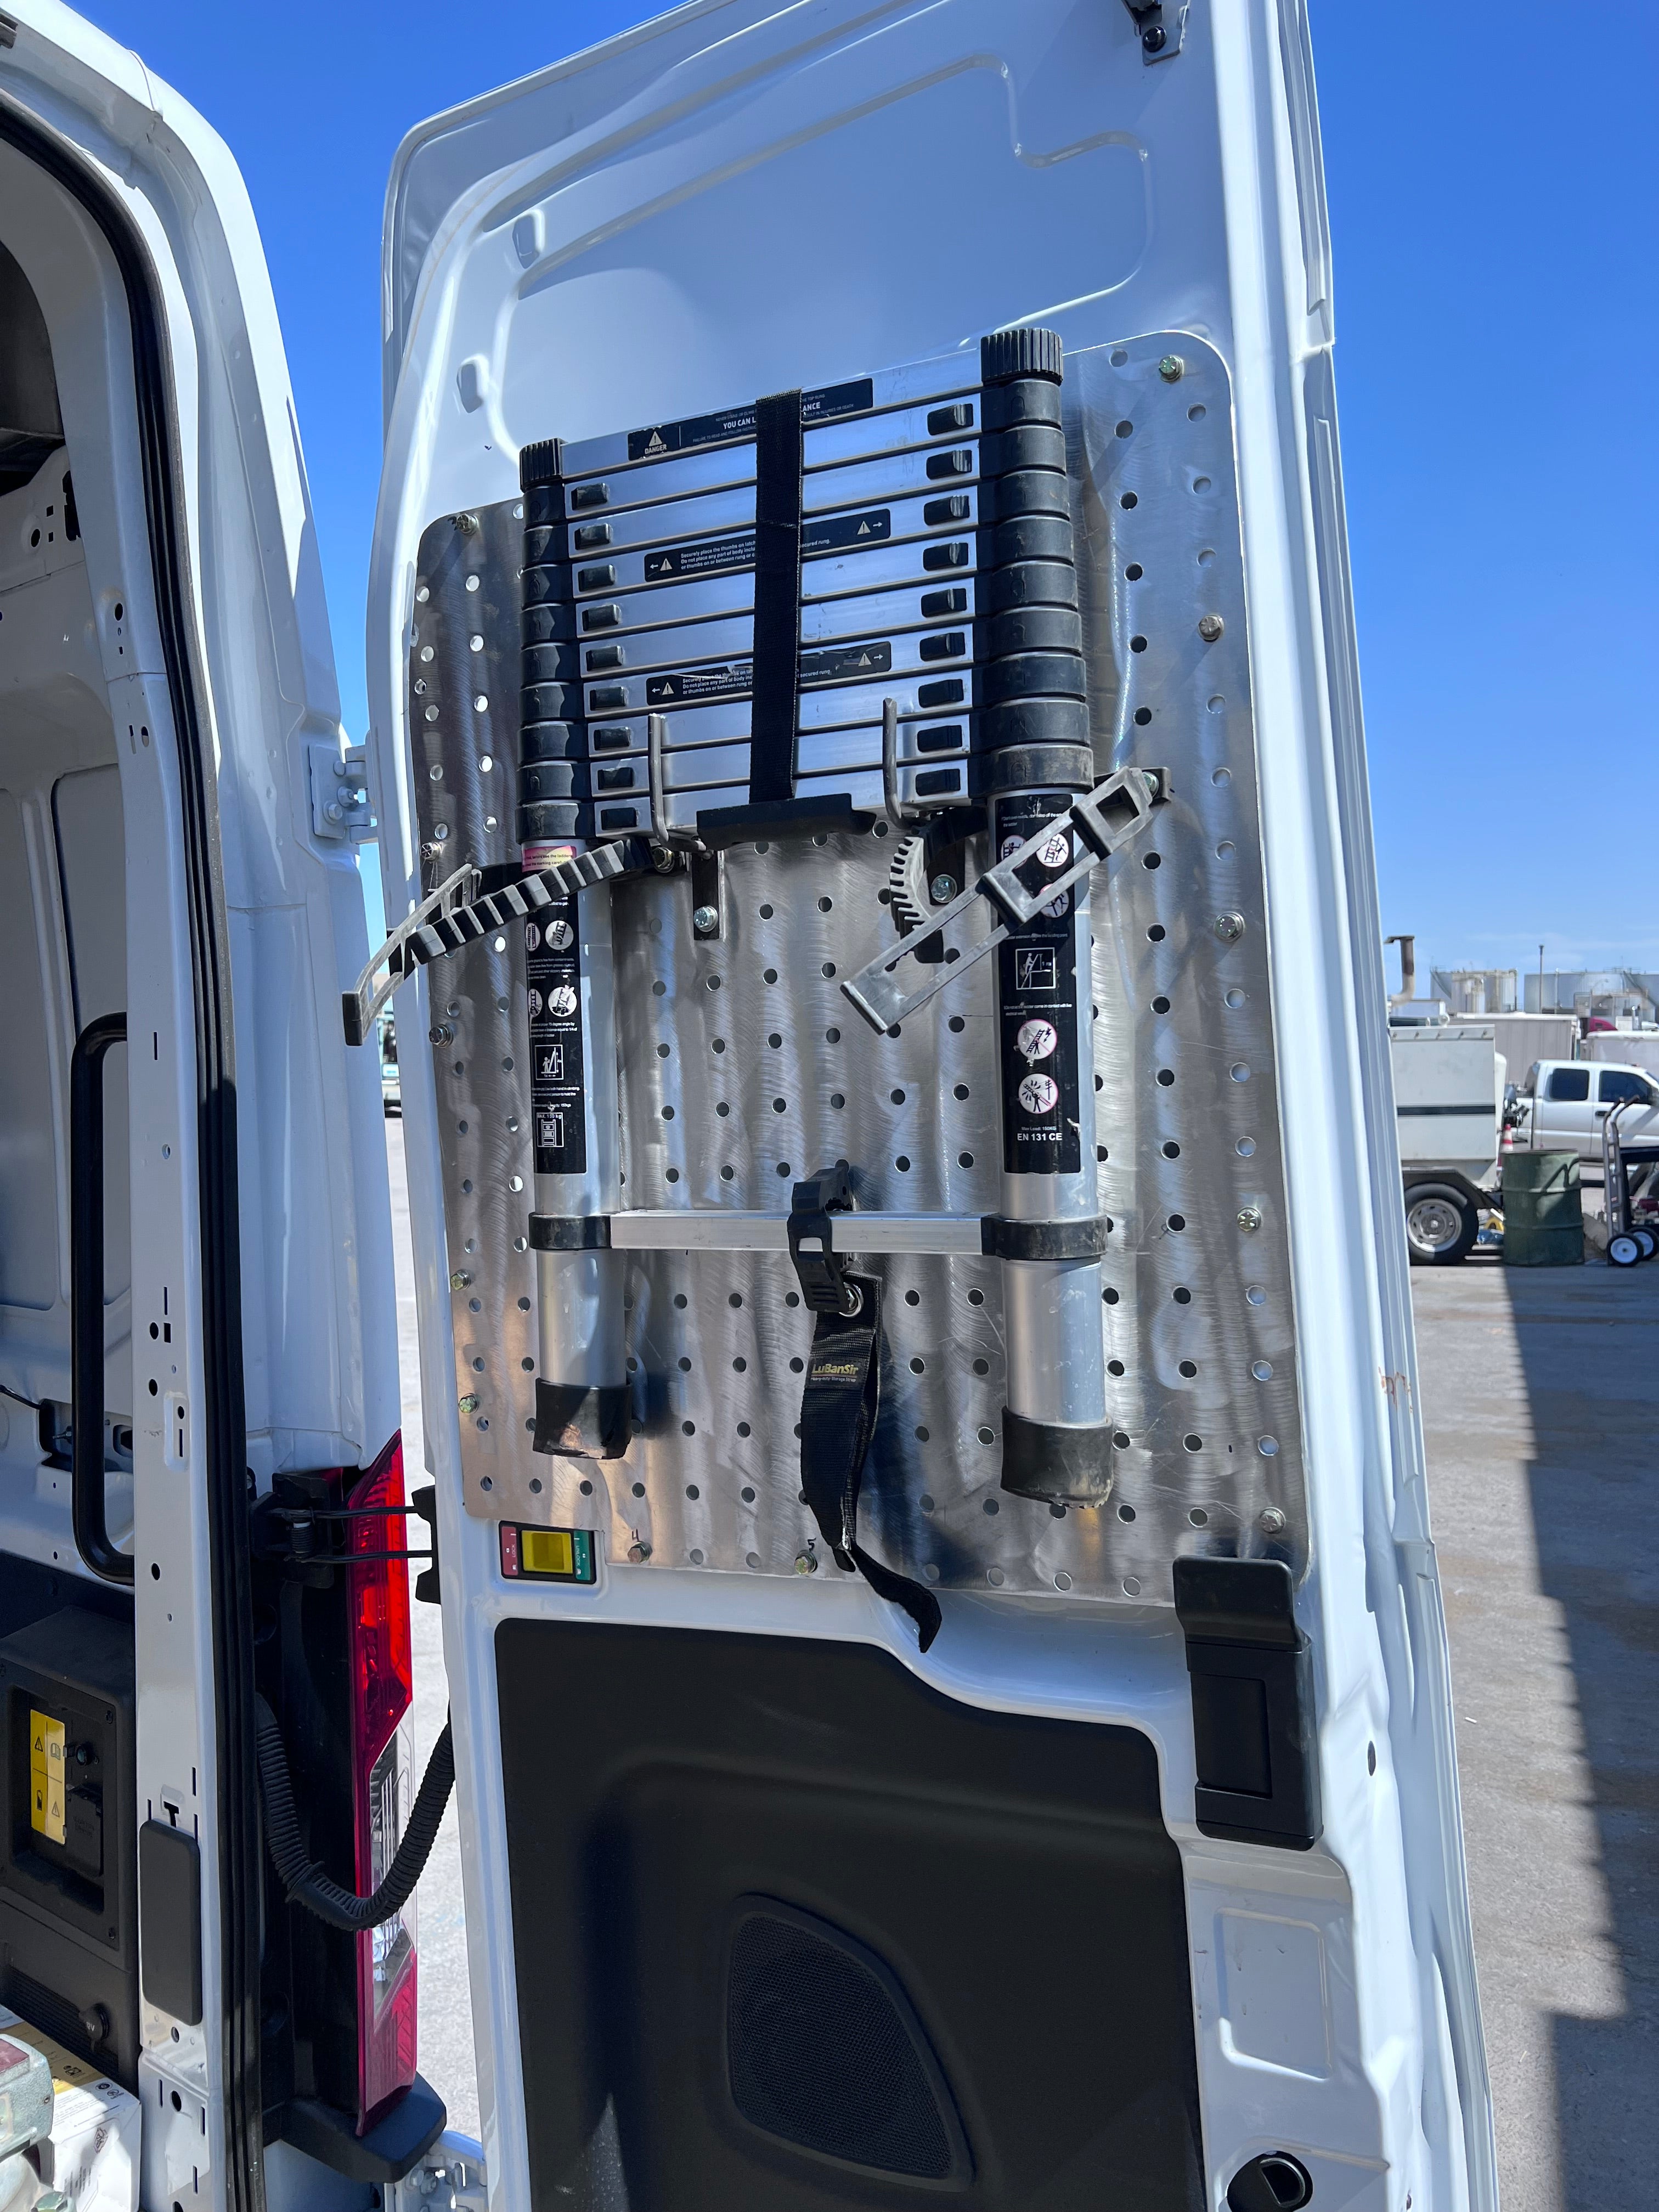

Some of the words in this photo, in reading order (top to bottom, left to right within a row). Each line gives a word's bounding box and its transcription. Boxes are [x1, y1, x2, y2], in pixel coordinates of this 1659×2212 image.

[724, 420, 736, 430] YOU
[737, 417, 751, 426] CAN
[645, 444, 668, 455] DANGER
[717, 682, 736, 690] between
[1017, 1133, 1029, 1141] EN
[1031, 1133, 1047, 1141] 131
[1048, 1132, 1063, 1141] CE
[811, 1363, 859, 1375] LuBanSir
